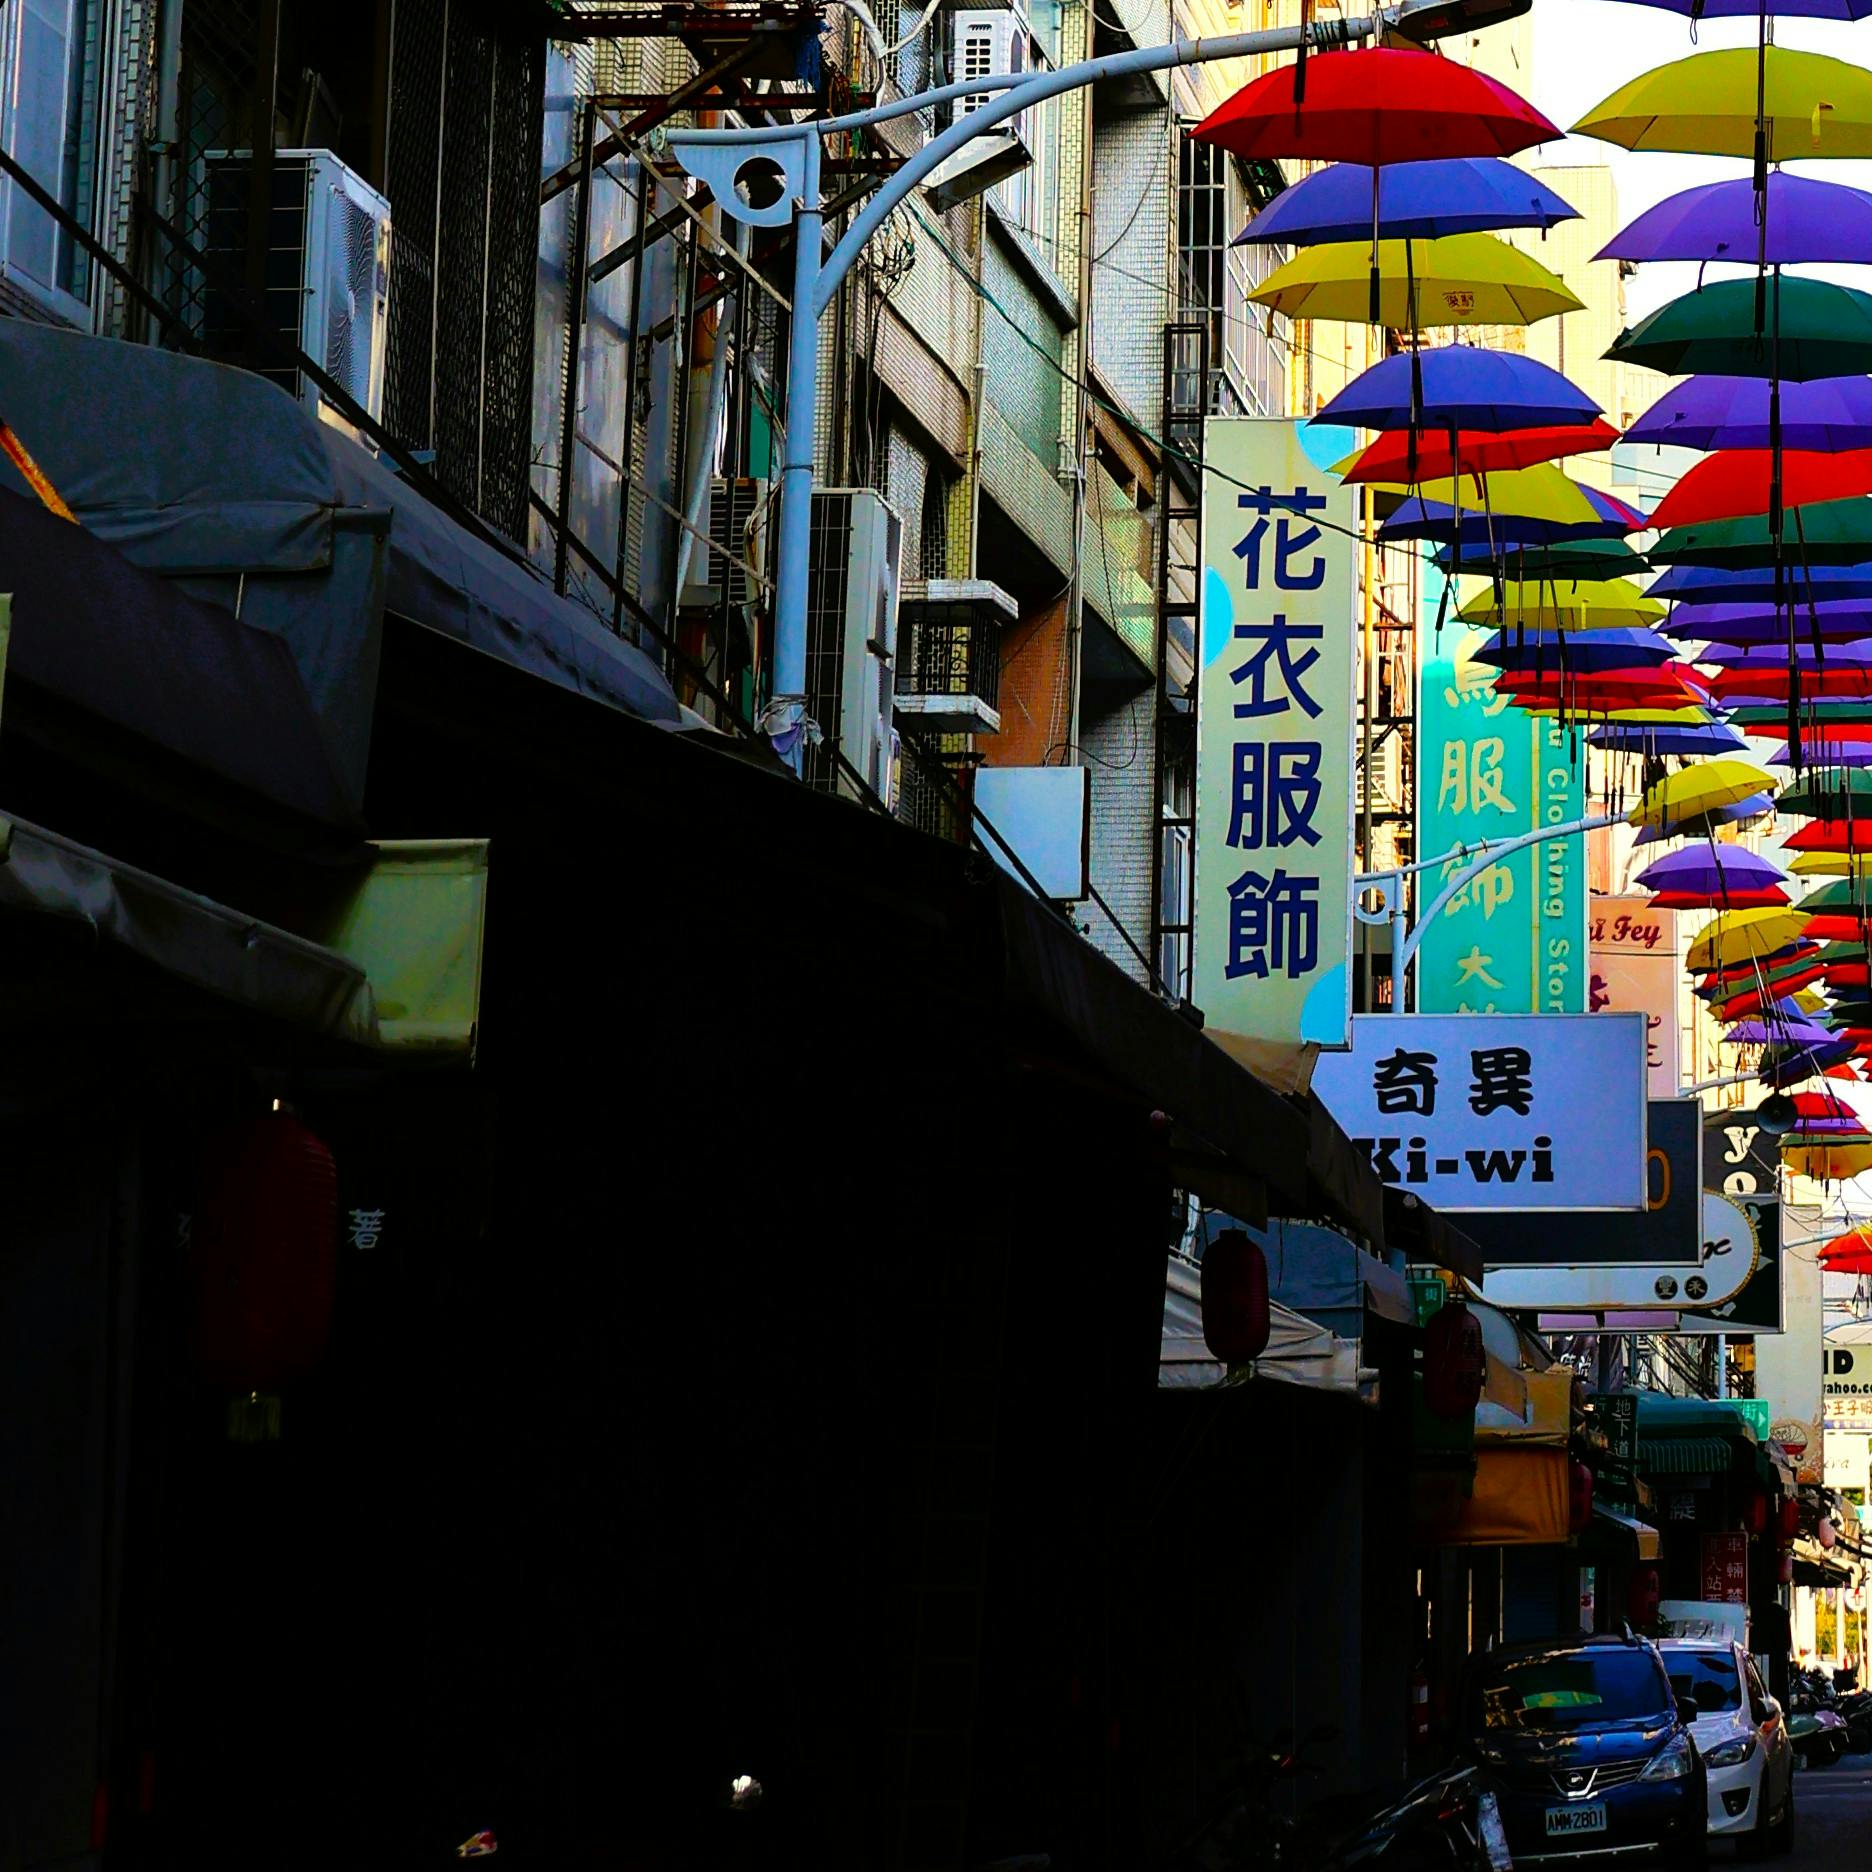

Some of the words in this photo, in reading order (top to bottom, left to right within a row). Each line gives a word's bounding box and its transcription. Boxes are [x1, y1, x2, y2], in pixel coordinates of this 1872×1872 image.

[1225, 485, 1328, 980] 花衣服飾
[1371, 1046, 1535, 1116] 奇異
[1354, 1135, 1555, 1184] Ki-wi
